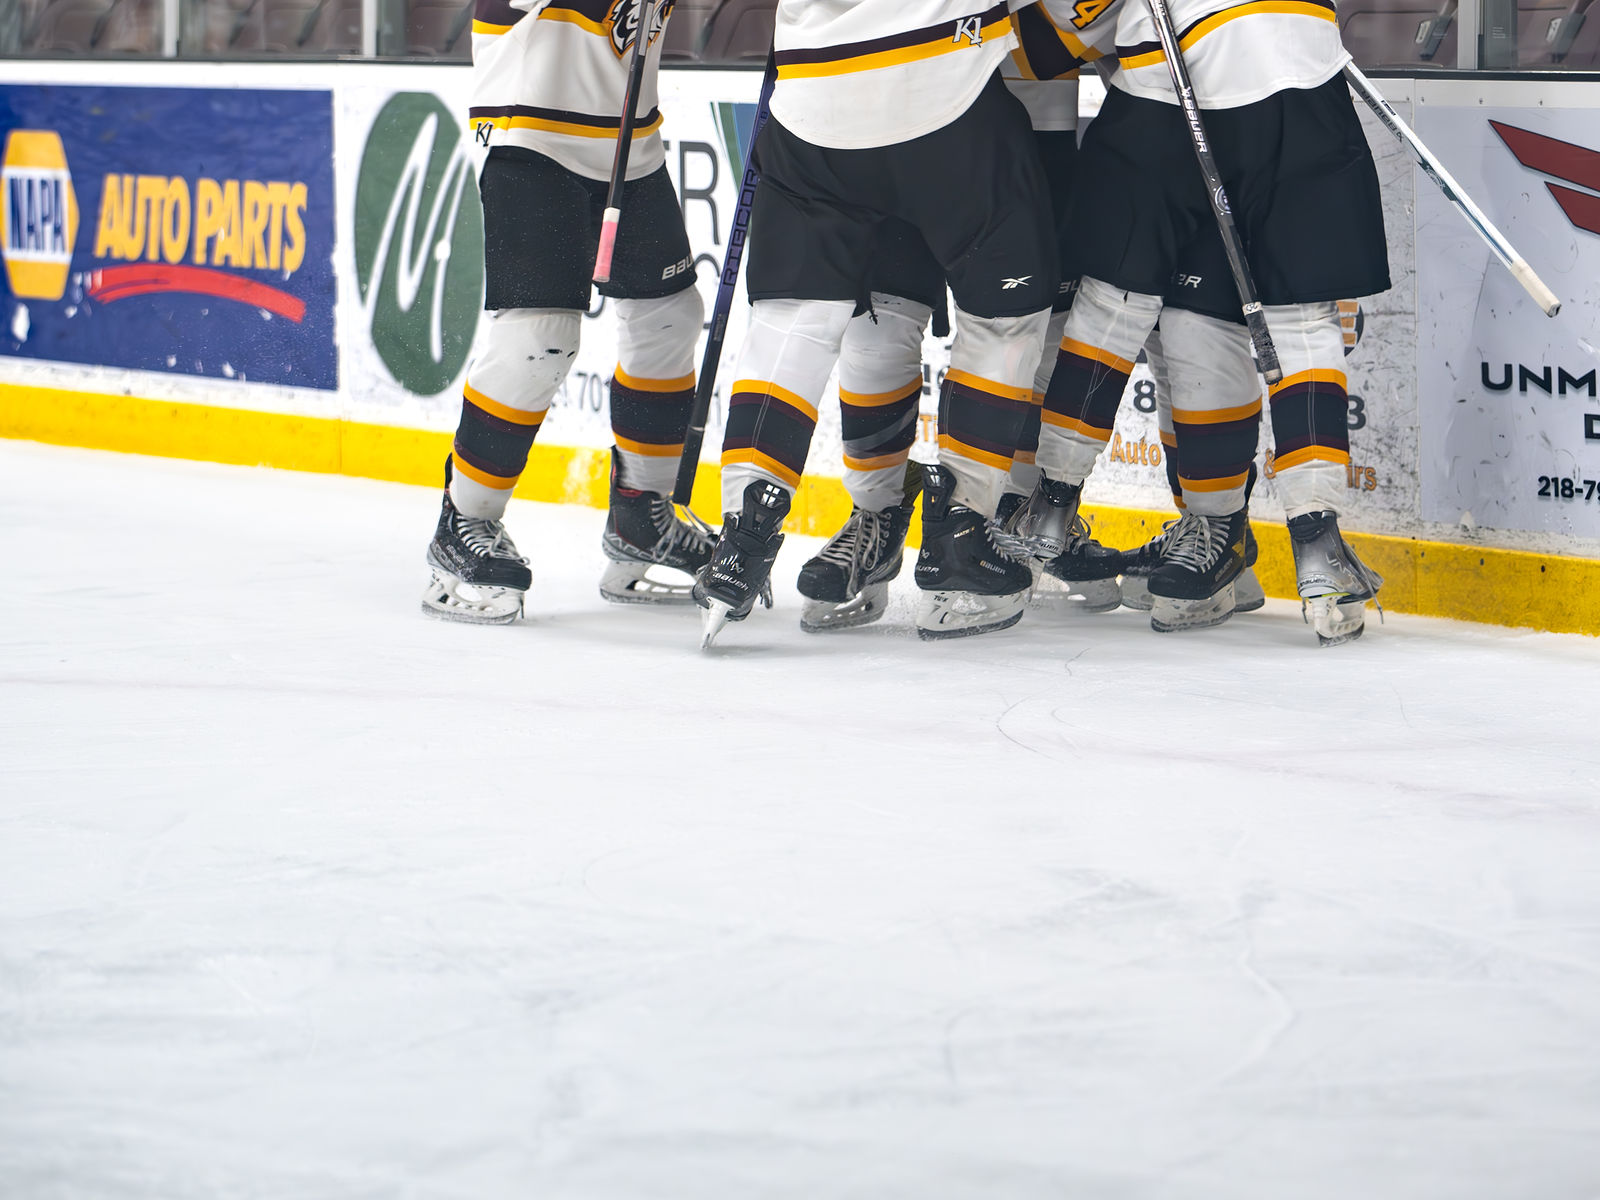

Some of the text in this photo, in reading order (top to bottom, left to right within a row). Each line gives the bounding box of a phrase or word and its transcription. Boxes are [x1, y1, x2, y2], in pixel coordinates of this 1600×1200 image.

[1184, 99, 1208, 152] BAUER
[8, 175, 67, 255] NAPA
[94, 173, 308, 273] AUTO PARTS
[1481, 362, 1597, 397] UNM
[1110, 432, 1162, 467] Auto
